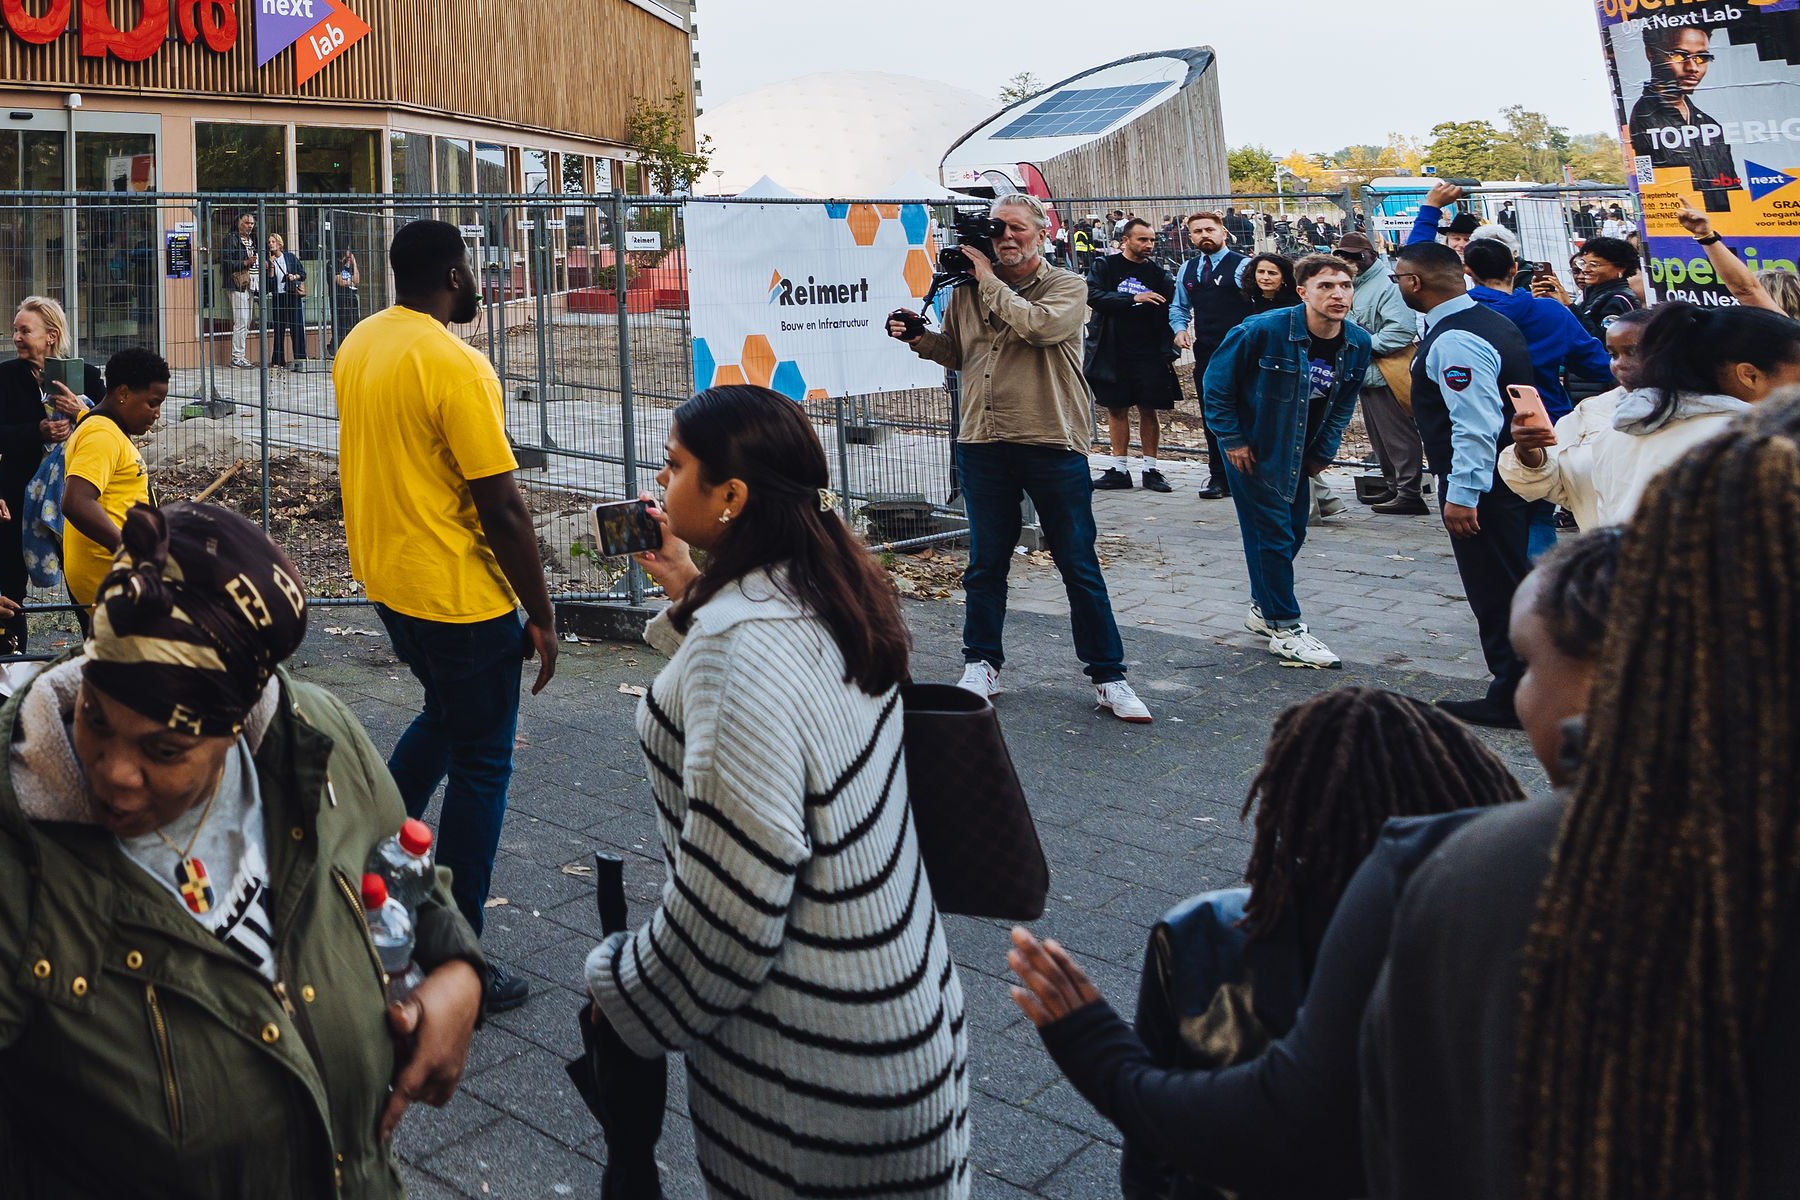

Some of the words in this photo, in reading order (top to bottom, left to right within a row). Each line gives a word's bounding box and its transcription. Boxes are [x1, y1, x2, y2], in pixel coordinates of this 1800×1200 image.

[1621, 15, 1653, 35] OBA
[1652, 9, 1701, 30] Next
[1702, 4, 1742, 23] Lab
[308, 21, 346, 62] lab
[1750, 174, 1785, 185] next
[779, 275, 869, 306] Reimert
[1703, 290, 1741, 307] Nex
[781, 319, 805, 332] Bouw
[806, 321, 817, 331] en
[818, 317, 870, 330] Infrastructuur
